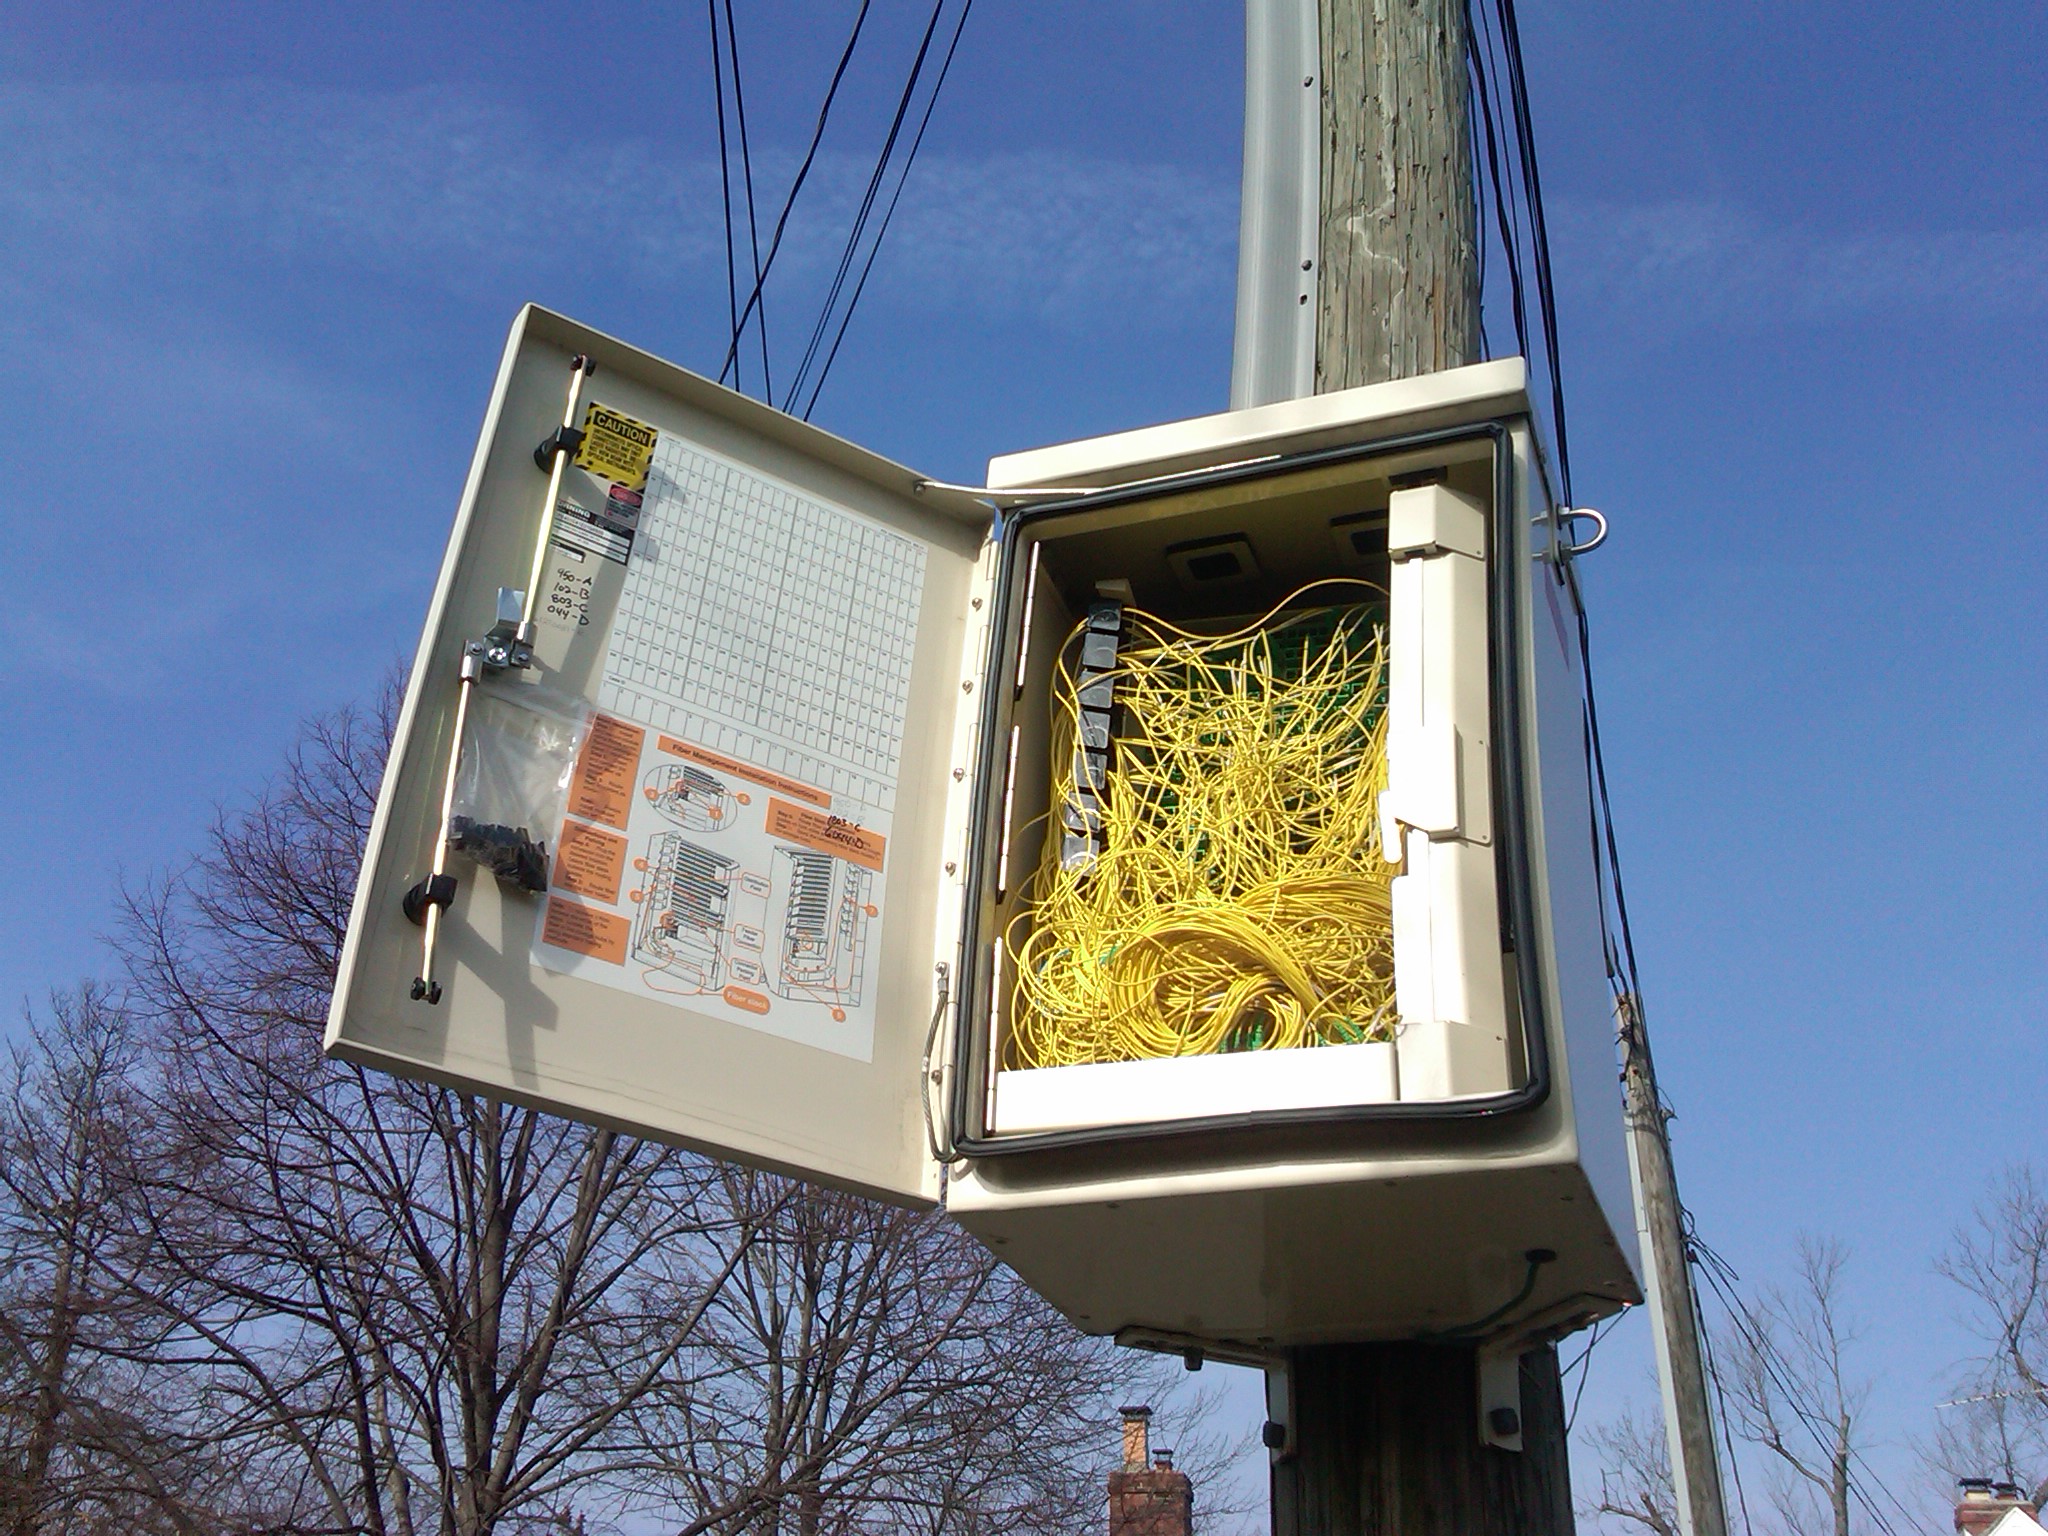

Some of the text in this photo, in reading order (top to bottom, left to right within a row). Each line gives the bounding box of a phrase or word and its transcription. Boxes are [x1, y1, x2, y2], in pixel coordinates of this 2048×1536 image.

[597, 414, 648, 444] CAUTION
[558, 568, 592, 586] 950-A
[554, 582, 590, 600] 102-B
[551, 594, 588, 612] 803-C
[547, 604, 590, 626] 044-D
[672, 744, 692, 754] Fiber
[692, 751, 737, 772] Management
[778, 781, 818, 800] Instructions
